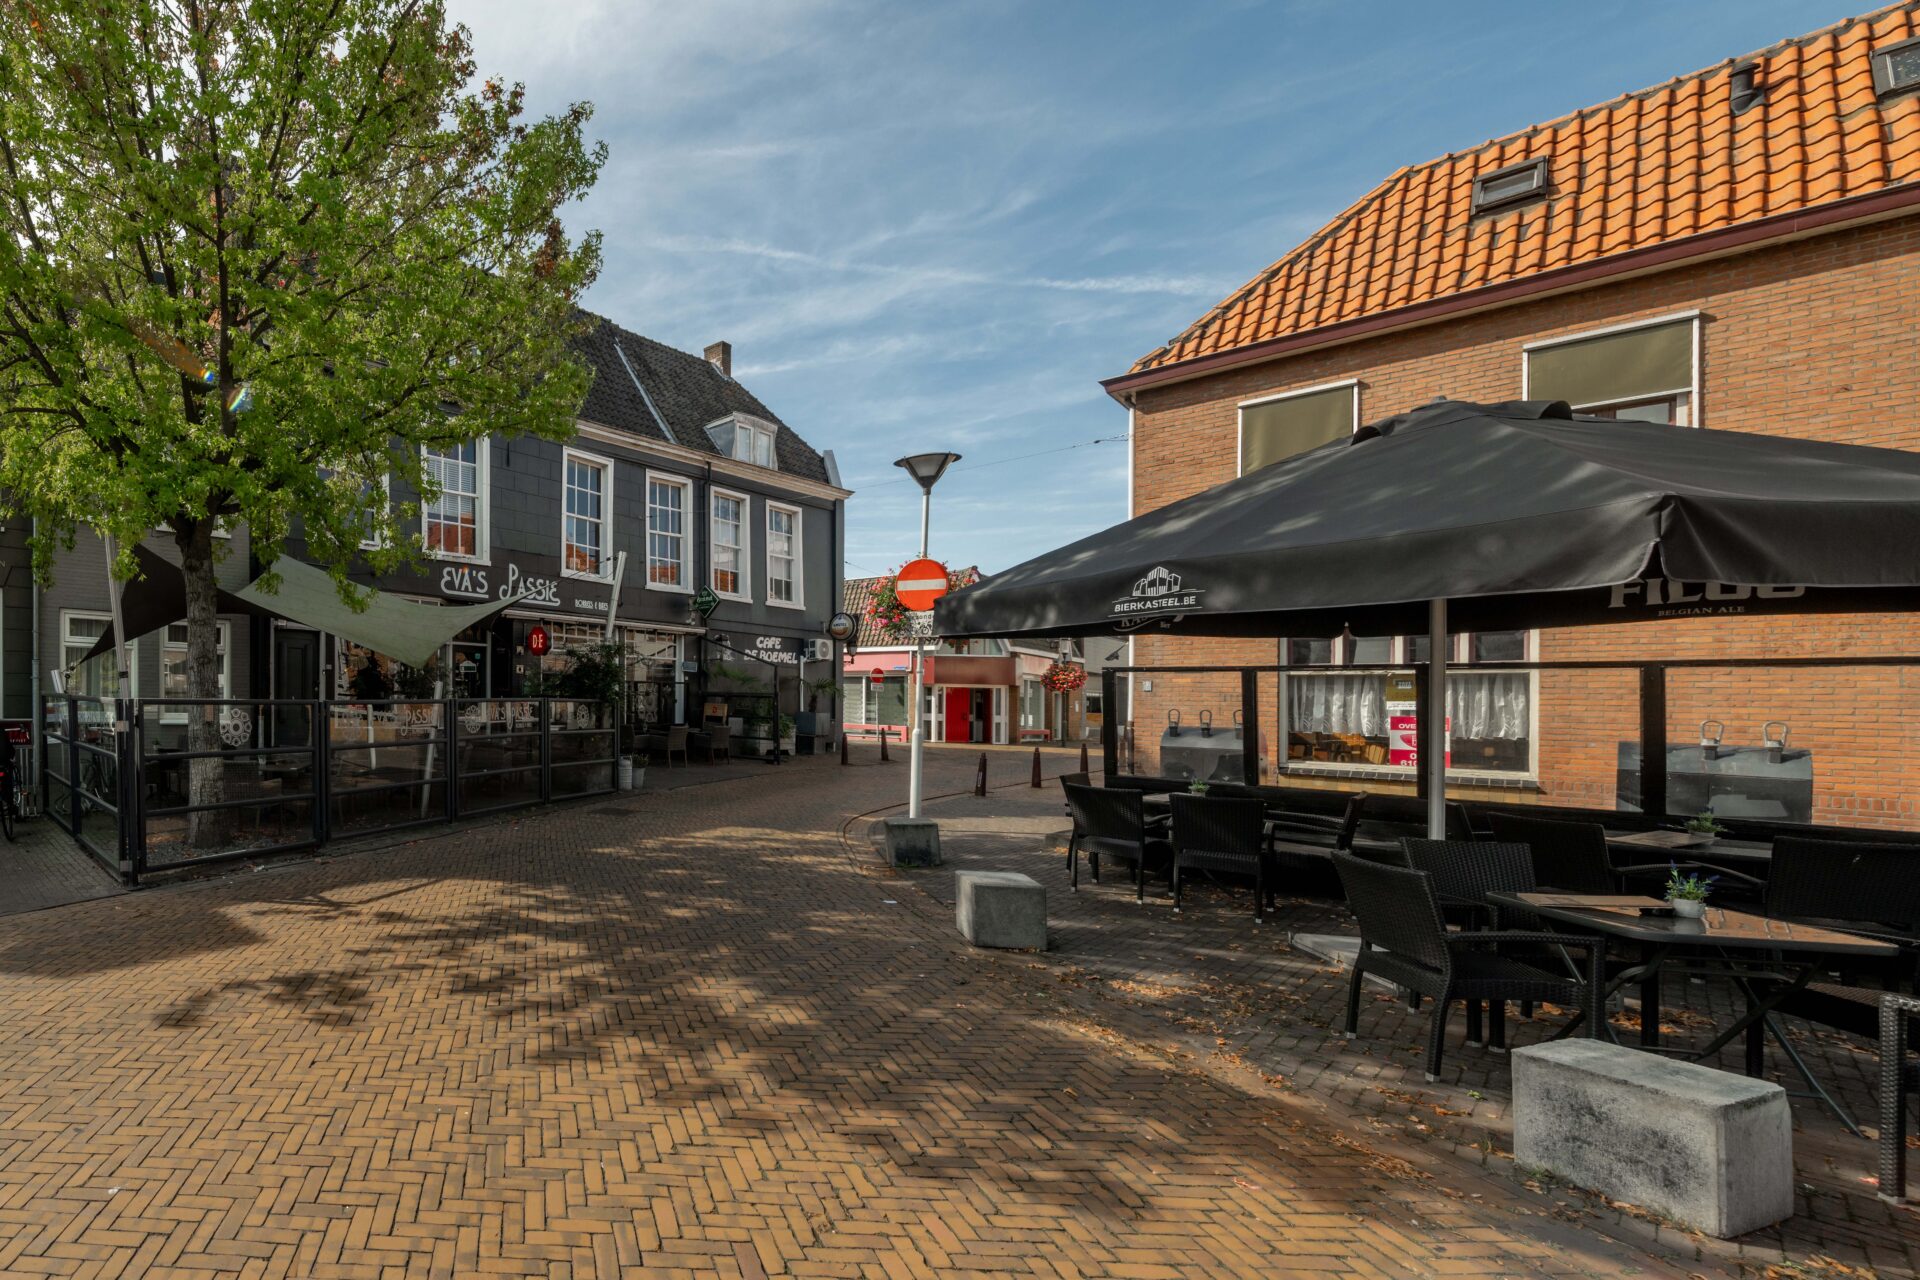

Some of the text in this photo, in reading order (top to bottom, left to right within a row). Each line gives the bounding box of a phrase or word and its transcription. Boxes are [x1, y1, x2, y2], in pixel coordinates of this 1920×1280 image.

[440, 563, 561, 607] EVA'S PASSIE
[1114, 596, 1196, 612] BIERKASTEEL.BE
[1657, 606, 1745, 617] BELGIAN ALE
[756, 636, 782, 650] CAFE
[743, 648, 758, 661] DE
